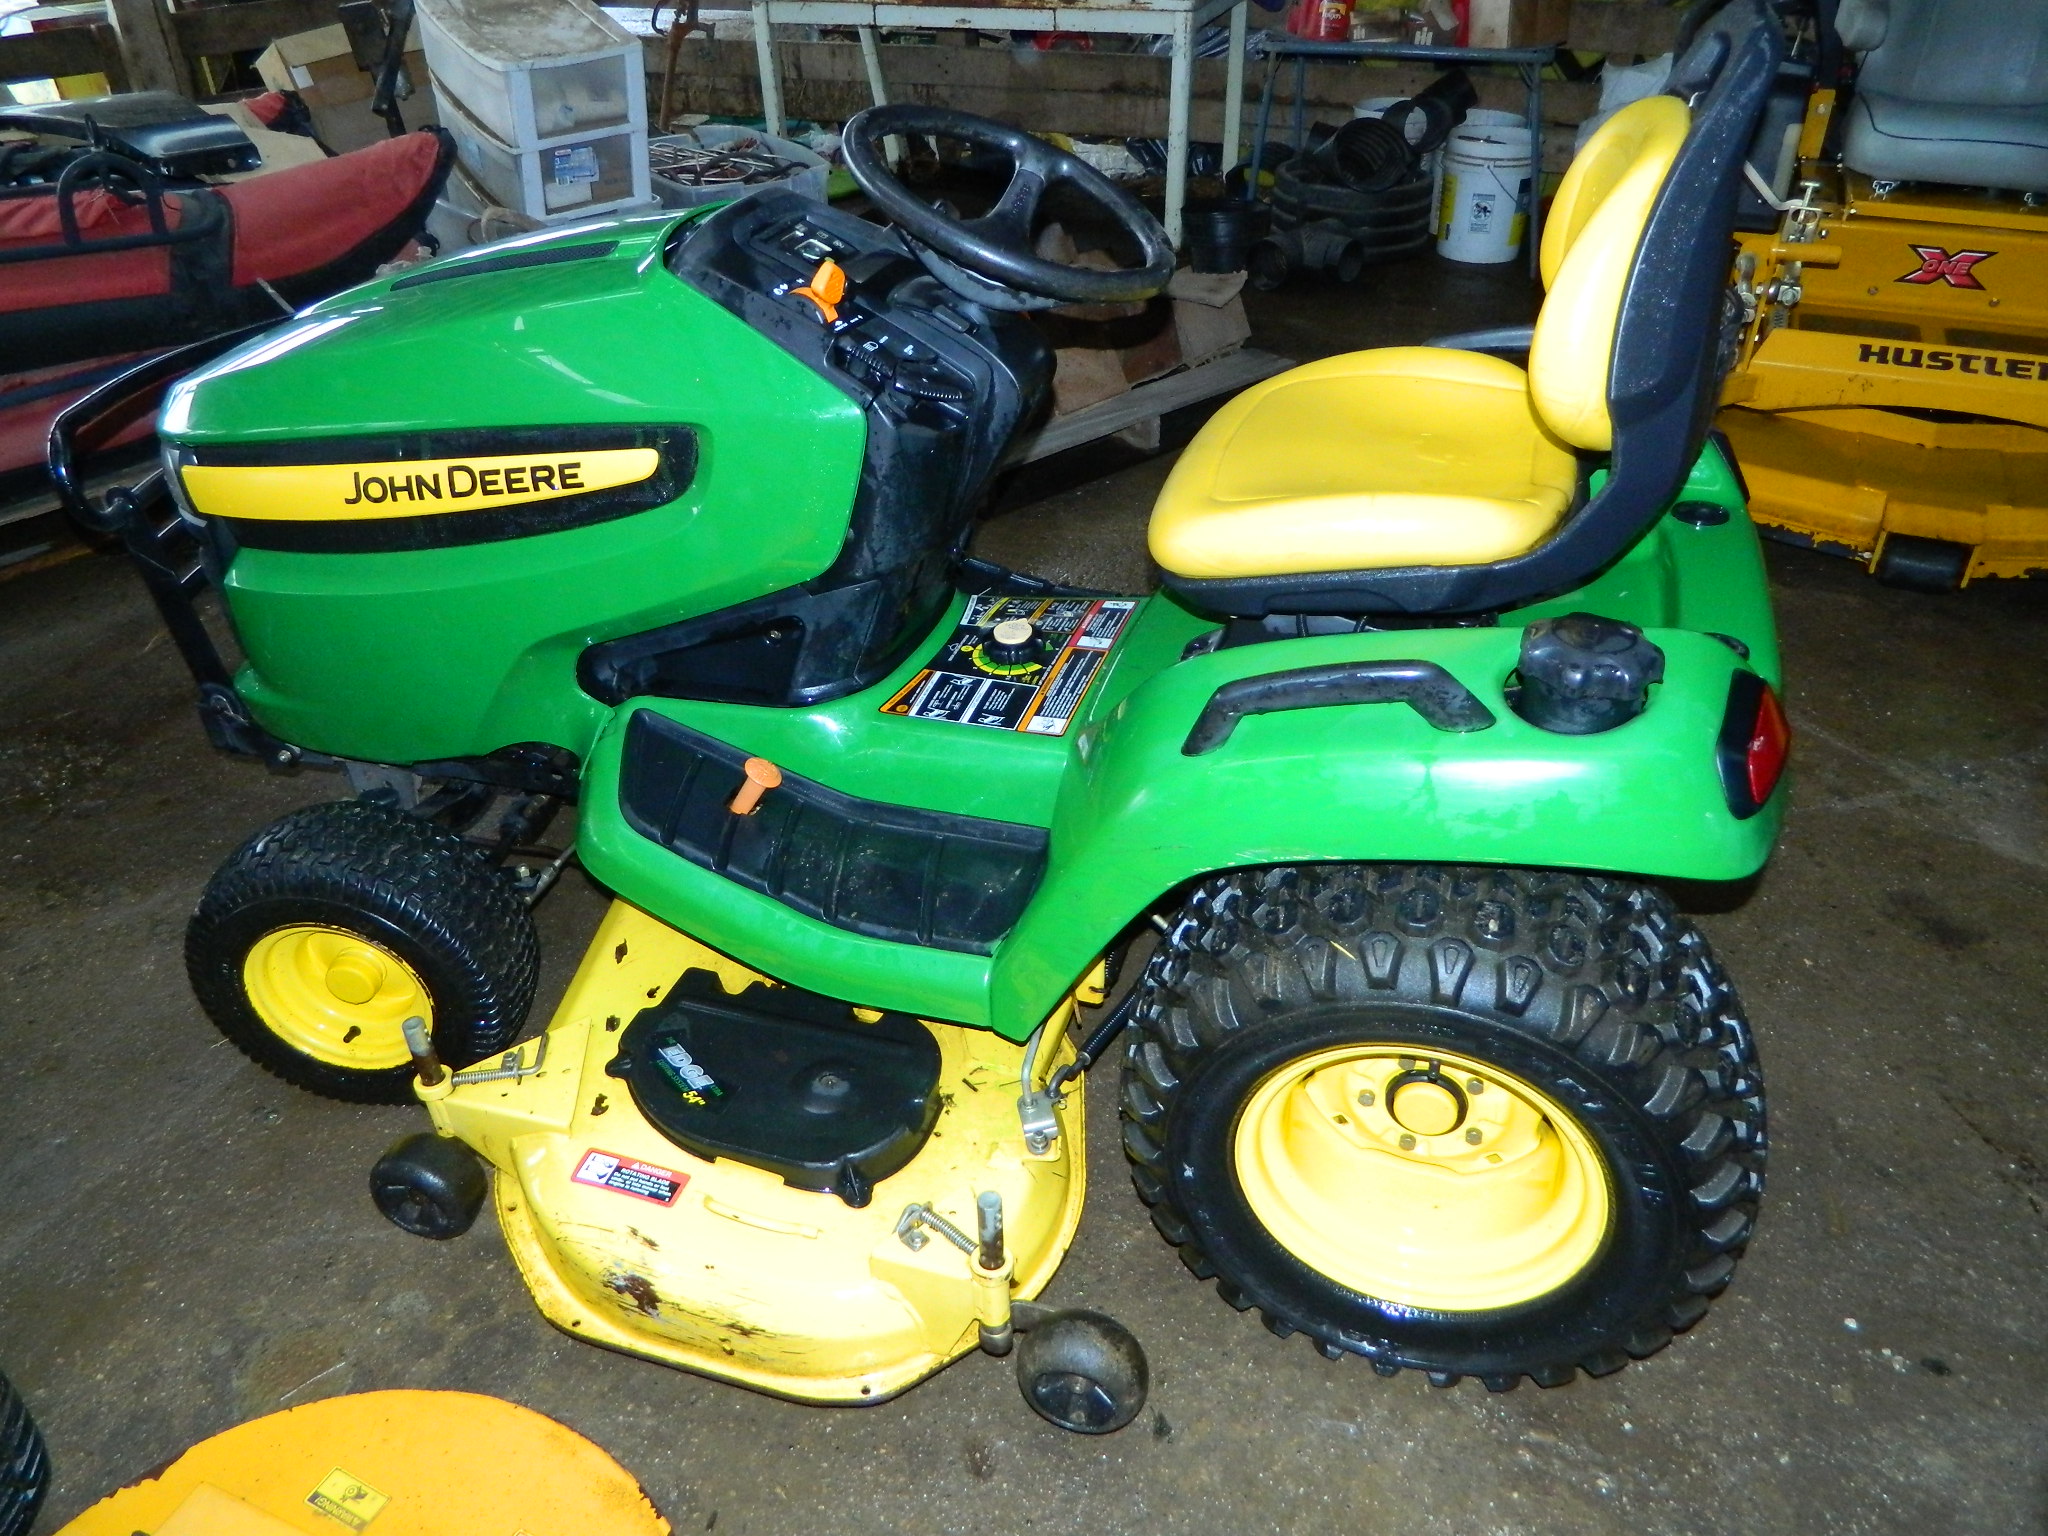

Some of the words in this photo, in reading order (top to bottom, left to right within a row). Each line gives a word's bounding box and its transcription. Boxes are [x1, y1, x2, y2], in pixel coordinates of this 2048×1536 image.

[1921, 259, 1971, 276] ONE
[344, 471, 443, 505] JOHN
[447, 462, 585, 499] DEERE
[658, 1043, 714, 1090] EDGE
[620, 1168, 651, 1180] ROTATING
[649, 1176, 670, 1186] BLADE
[639, 1163, 673, 1178] DANGER
